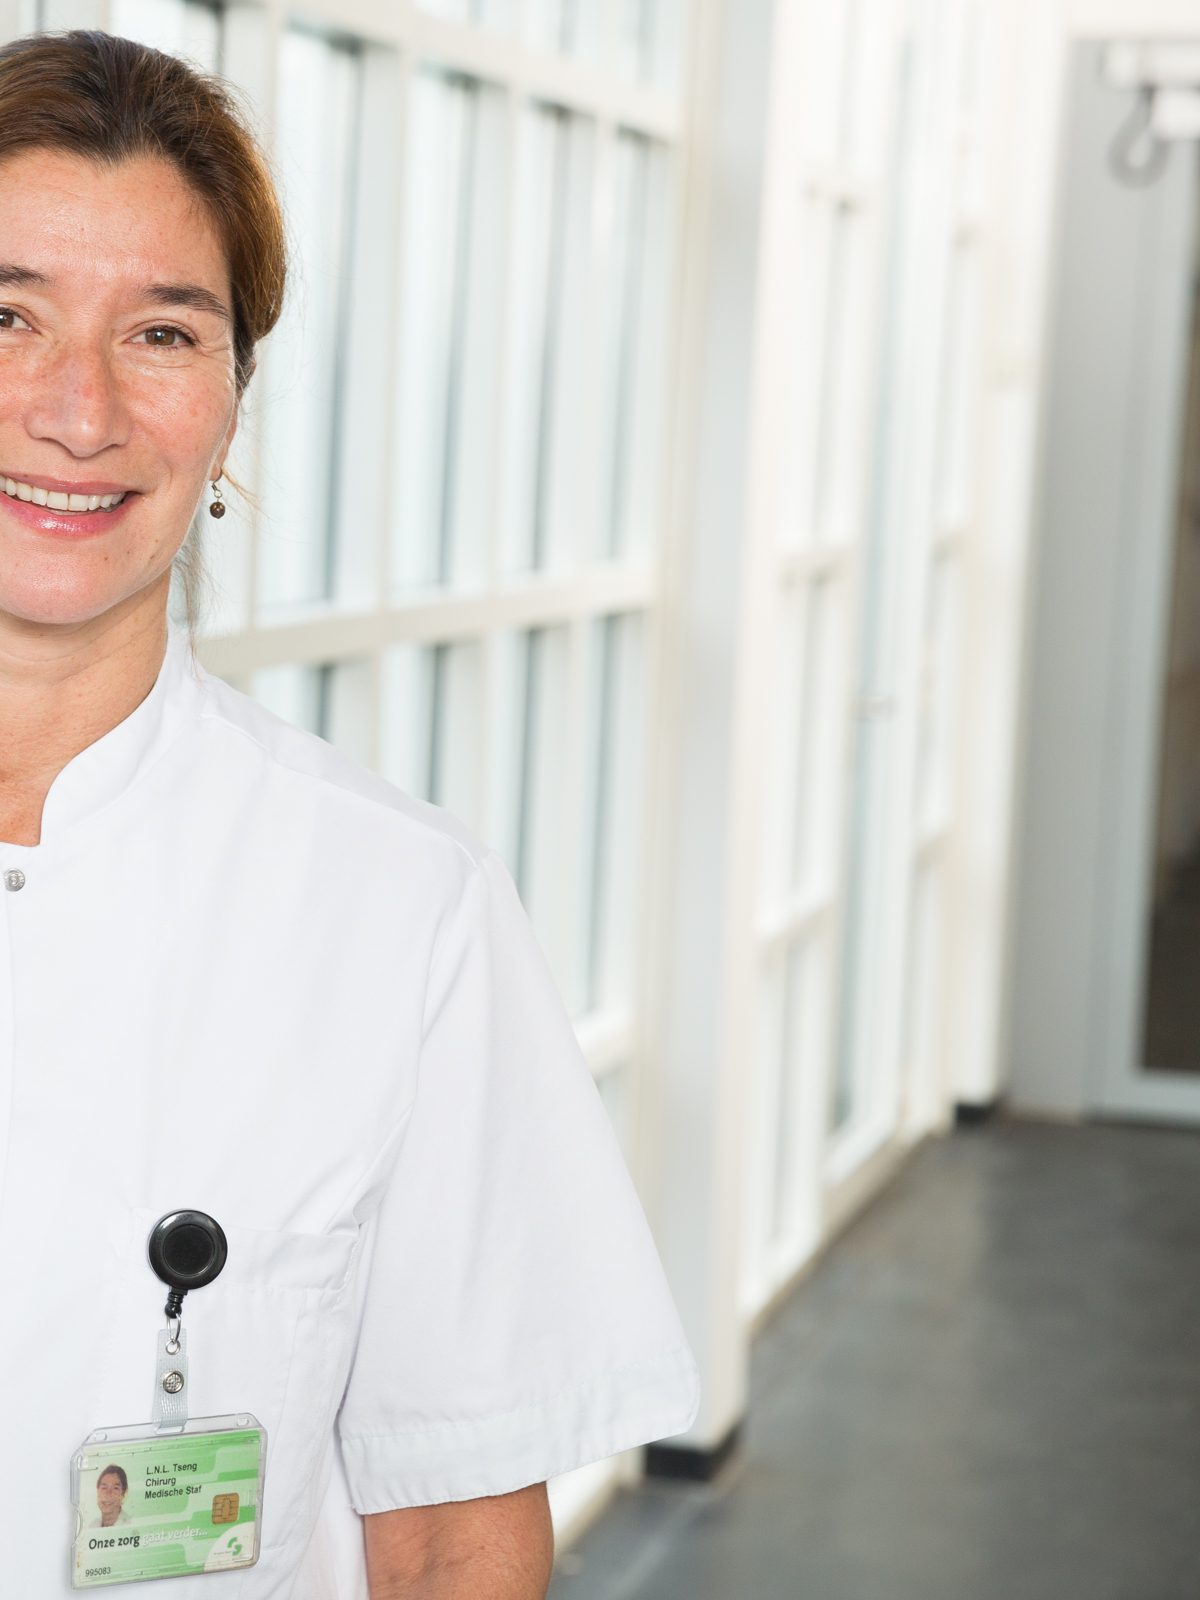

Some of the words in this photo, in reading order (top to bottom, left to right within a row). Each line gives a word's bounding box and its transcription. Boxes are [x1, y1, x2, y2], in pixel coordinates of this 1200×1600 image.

[146, 1465, 170, 1475] L.N.L.
[173, 1463, 198, 1472] Tseng
[145, 1477, 177, 1487] Chirurg
[144, 1488, 184, 1499] Medische
[185, 1485, 202, 1495] Staf
[88, 1538, 116, 1550] Onze
[117, 1535, 141, 1548] zorg
[142, 1531, 166, 1547] gaat
[85, 1566, 112, 1577] 995083
